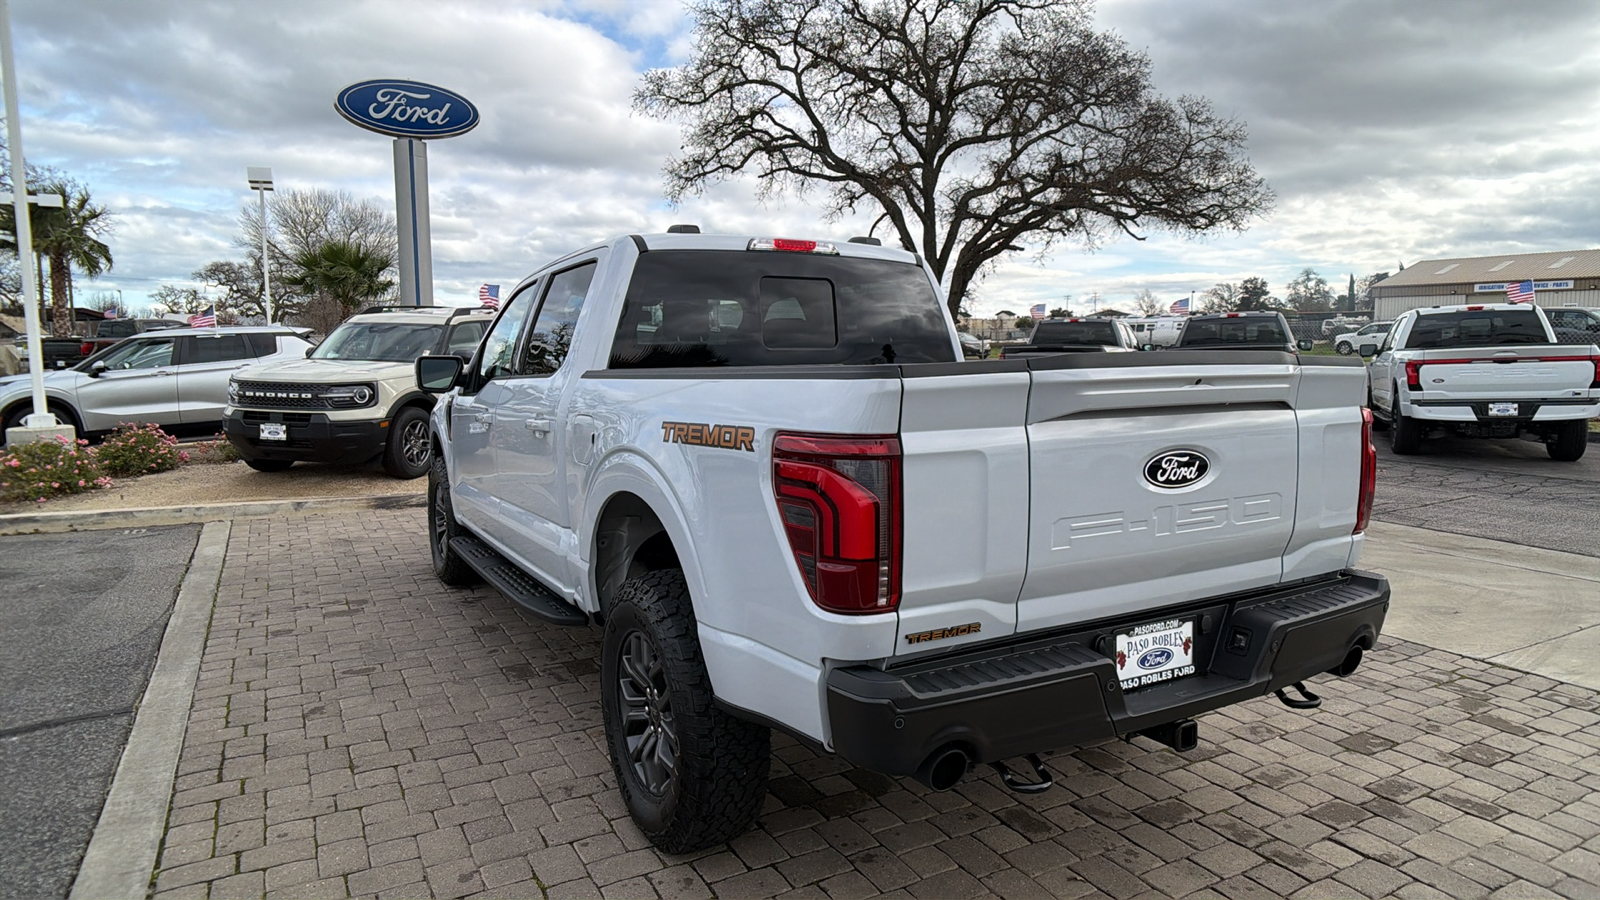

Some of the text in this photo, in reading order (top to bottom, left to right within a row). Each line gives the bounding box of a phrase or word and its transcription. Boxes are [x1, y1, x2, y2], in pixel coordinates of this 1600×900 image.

[368, 88, 452, 125] Ford
[245, 391, 312, 399] BRONCO
[661, 421, 755, 452] TREMOR
[1156, 455, 1200, 482] Ford
[1051, 491, 1283, 550] F-150
[905, 622, 981, 644] TREMOR
[1134, 619, 1179, 635] PASOFORD.COM
[1127, 631, 1184, 658] PASO ROBLES
[1144, 651, 1168, 667] Ford
[1141, 670, 1172, 685] ROBLES
